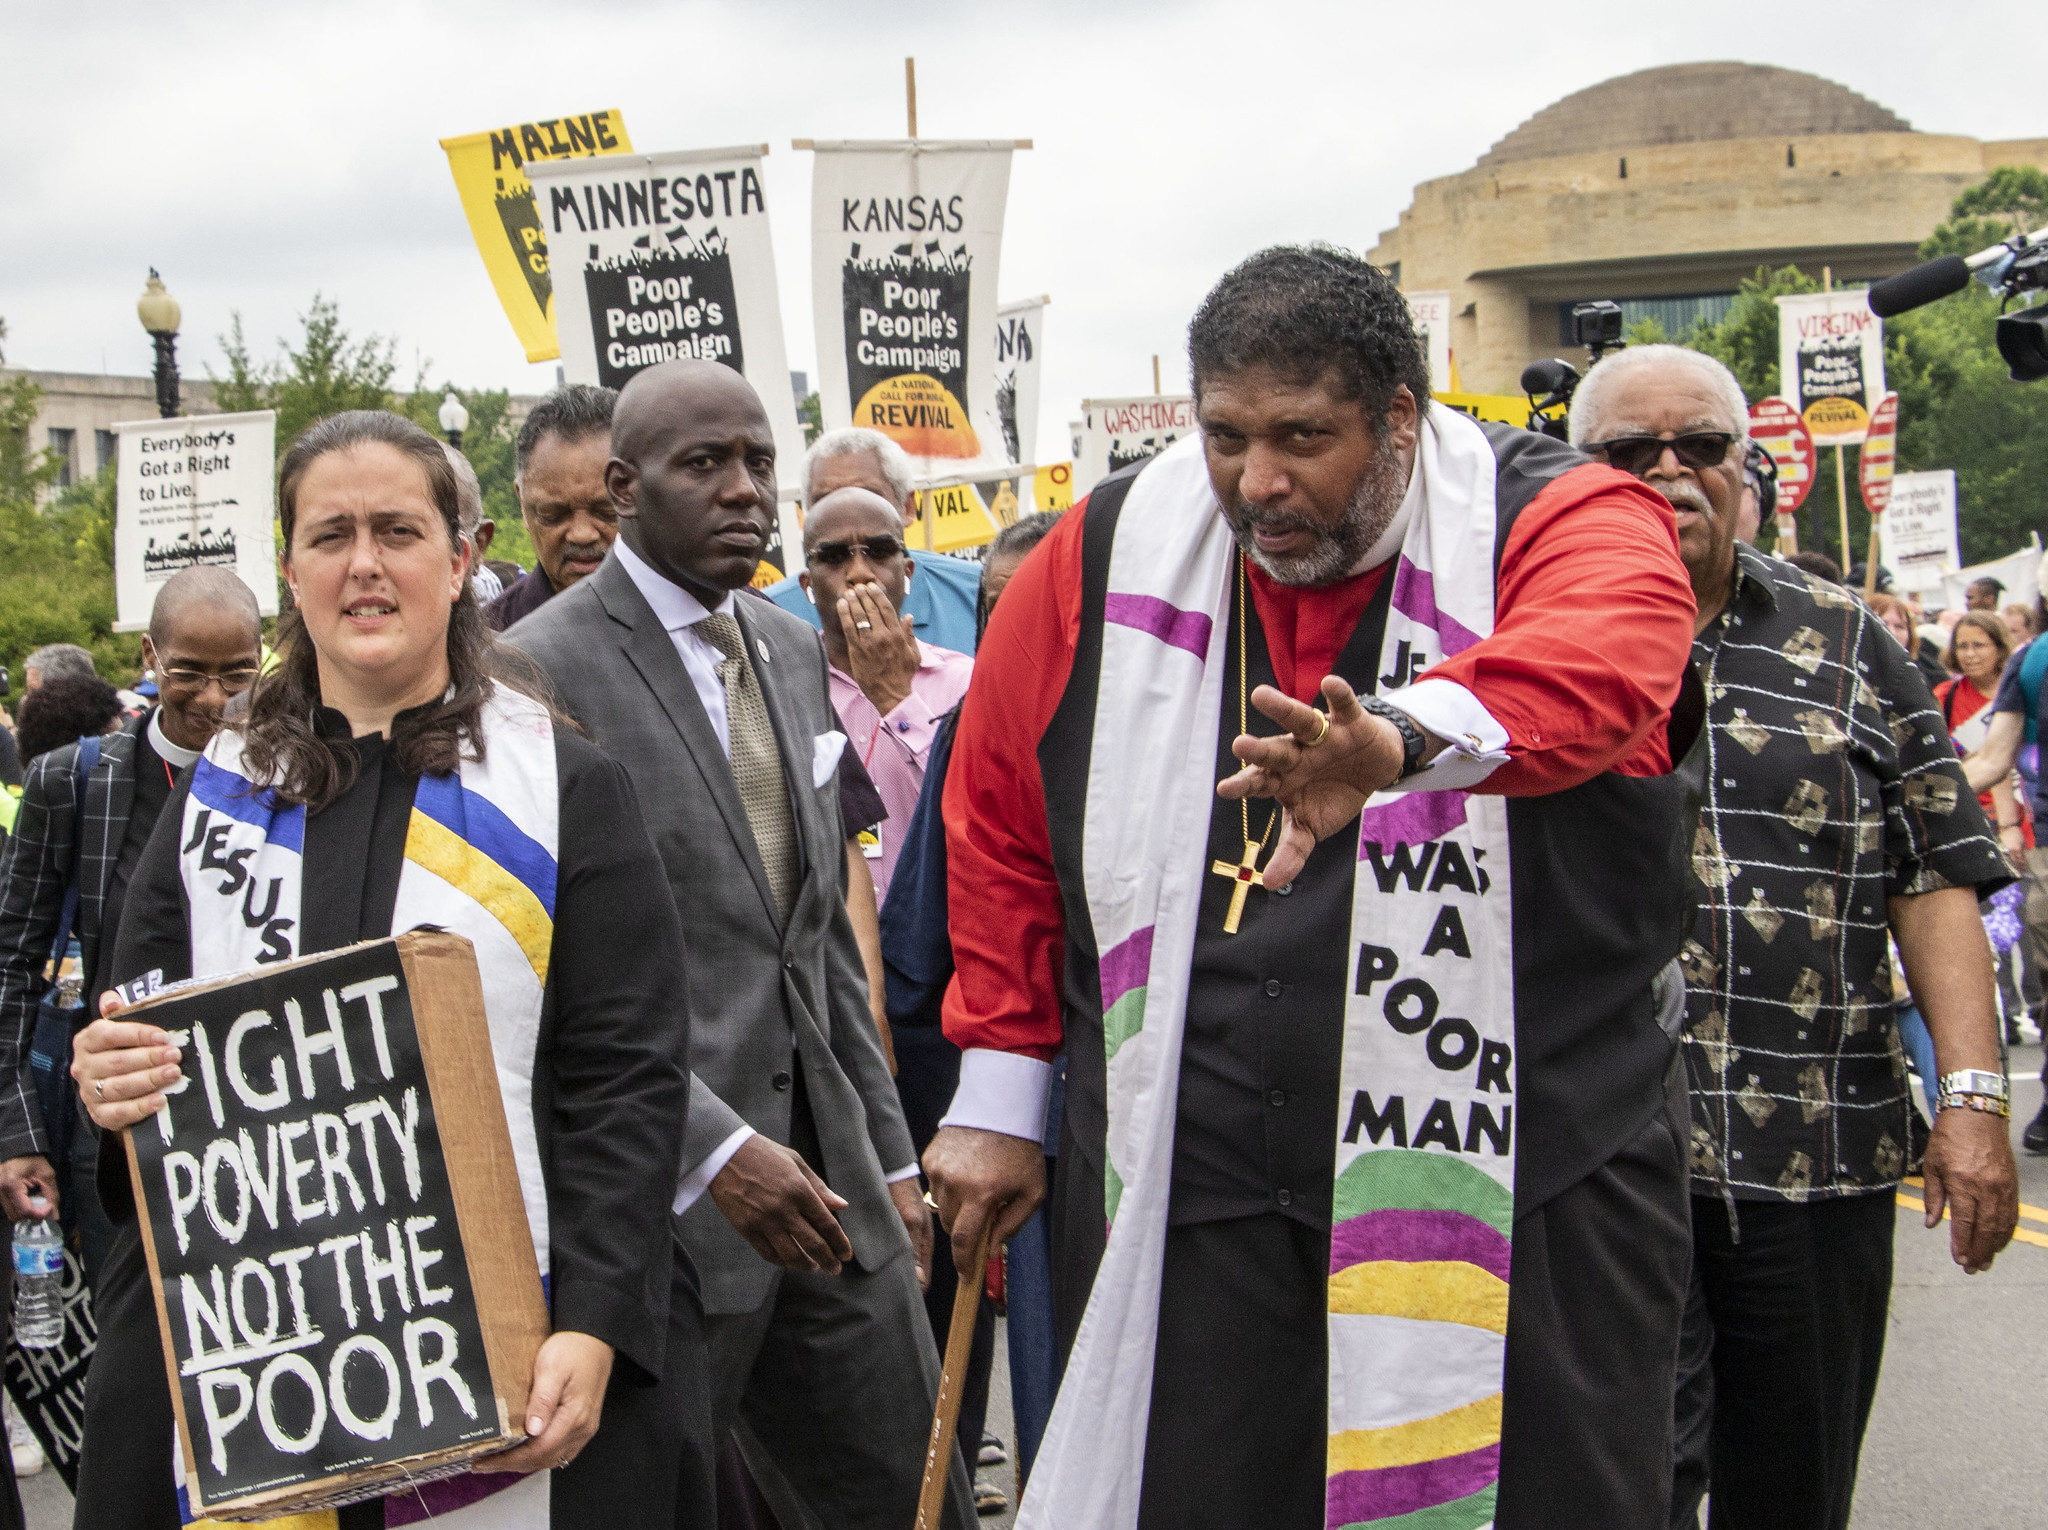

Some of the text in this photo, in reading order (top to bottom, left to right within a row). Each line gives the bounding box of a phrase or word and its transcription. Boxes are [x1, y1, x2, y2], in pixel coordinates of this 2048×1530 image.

[489, 111, 619, 170] MAINE
[550, 167, 765, 233] MINNESOTA
[842, 195, 964, 233] KANSAS
[627, 274, 693, 306] Poor
[883, 280, 942, 310] Poor
[606, 297, 724, 338] People's
[859, 307, 958, 342] People's
[607, 333, 732, 369] Campaign
[857, 340, 962, 373] Campaign
[871, 403, 955, 429] REVIVAL
[141, 430, 235, 453] Everybody's
[140, 454, 231, 477] Got a Right
[139, 486, 155, 501] to
[183, 809, 295, 964] JESUS
[1422, 905, 1471, 959] A
[1354, 940, 1512, 1094] POOR
[1342, 1089, 1512, 1156] MAN
[163, 1086, 421, 1256] POVERTY
[180, 1246, 320, 1364] NOT
[318, 1214, 454, 1329] THE
[196, 1316, 478, 1477] POOR
